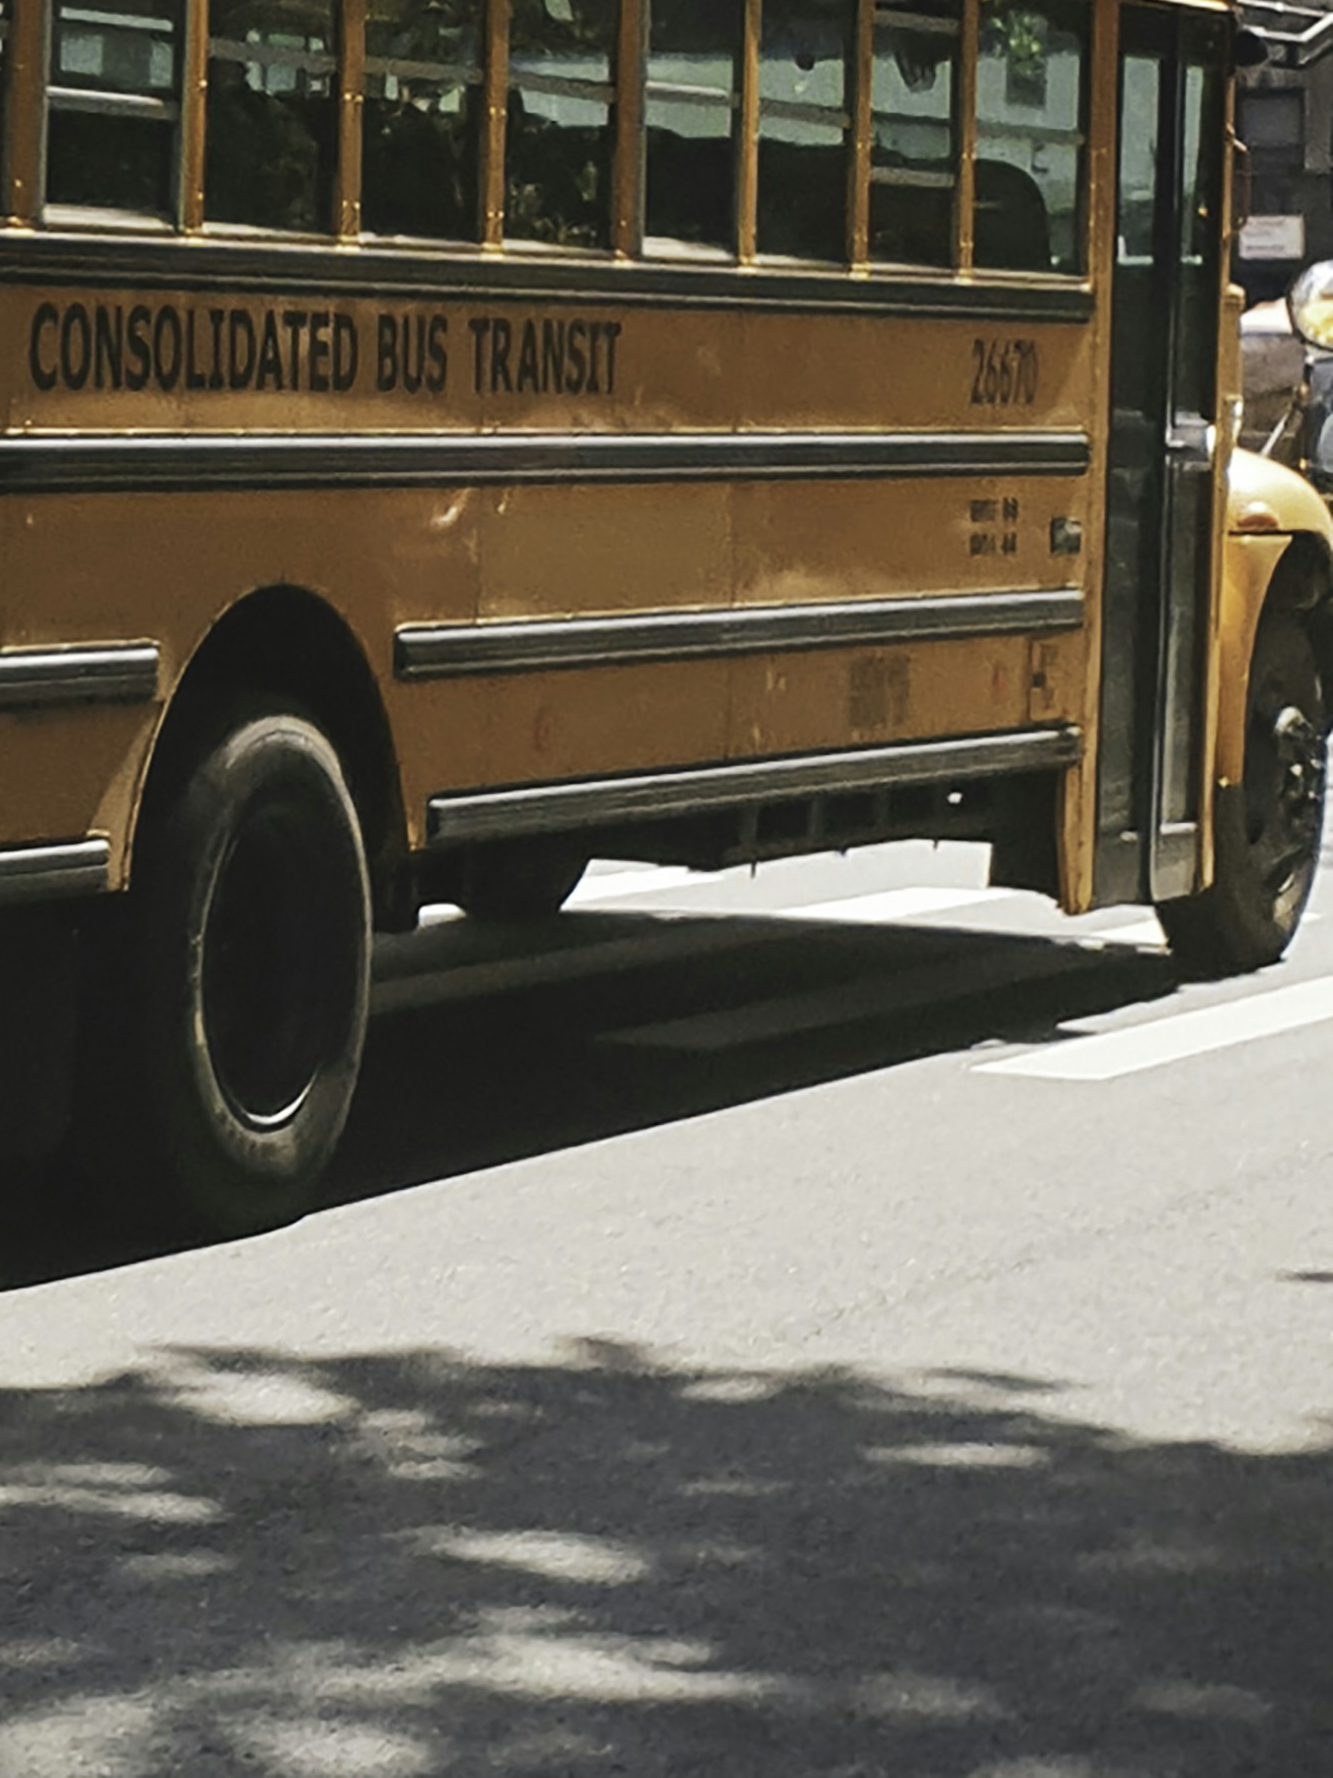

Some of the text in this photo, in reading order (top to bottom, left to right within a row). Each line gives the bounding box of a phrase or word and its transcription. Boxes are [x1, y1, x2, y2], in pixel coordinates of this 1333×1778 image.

[30, 301, 622, 396] CONSOLIDATED BUS TRANSIT
[970, 337, 1039, 406] 26670
